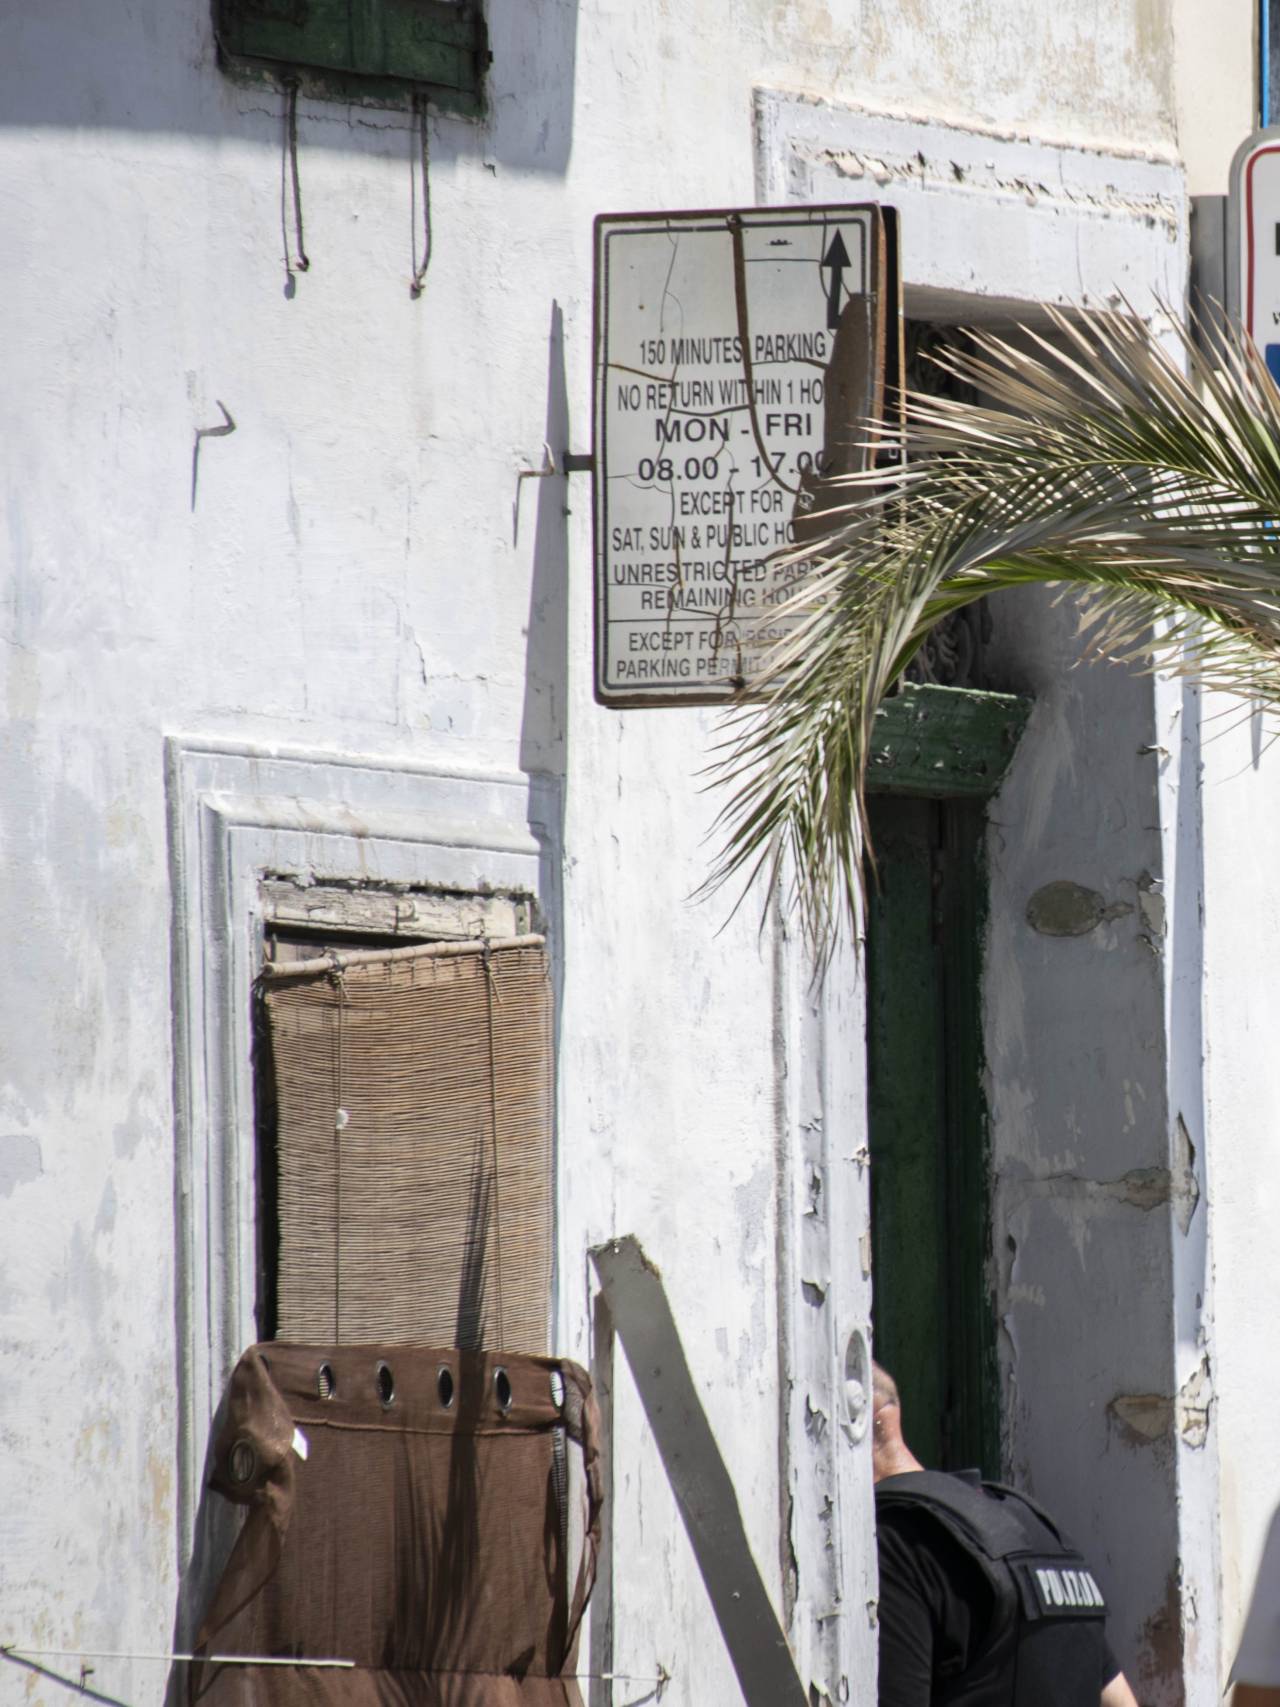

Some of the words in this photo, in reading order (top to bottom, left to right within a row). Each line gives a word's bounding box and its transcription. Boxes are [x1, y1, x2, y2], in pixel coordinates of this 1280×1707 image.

[640, 339, 666, 365] 150
[670, 336, 743, 366] MINUTES
[755, 331, 827, 361] PARKING
[618, 384, 641, 411] NO
[646, 380, 714, 410] RETURN
[719, 378, 781, 406] WITHIN
[787, 380, 793, 405] 1
[655, 418, 730, 443] MON
[766, 412, 812, 437] FRI
[638, 456, 719, 482] 08.00
[680, 489, 745, 516] EXCEPT
[750, 489, 784, 514] FOR
[612, 527, 645, 556] SAT,
[649, 525, 686, 552] SUN
[691, 525, 702, 550] &
[706, 521, 769, 549] PUBLIC
[614, 559, 767, 586] UNRESTRICTED
[641, 586, 756, 611] REMAINING
[628, 630, 695, 652] EXCEPT
[698, 629, 738, 651] FOR
[616, 658, 691, 680] PARKING
